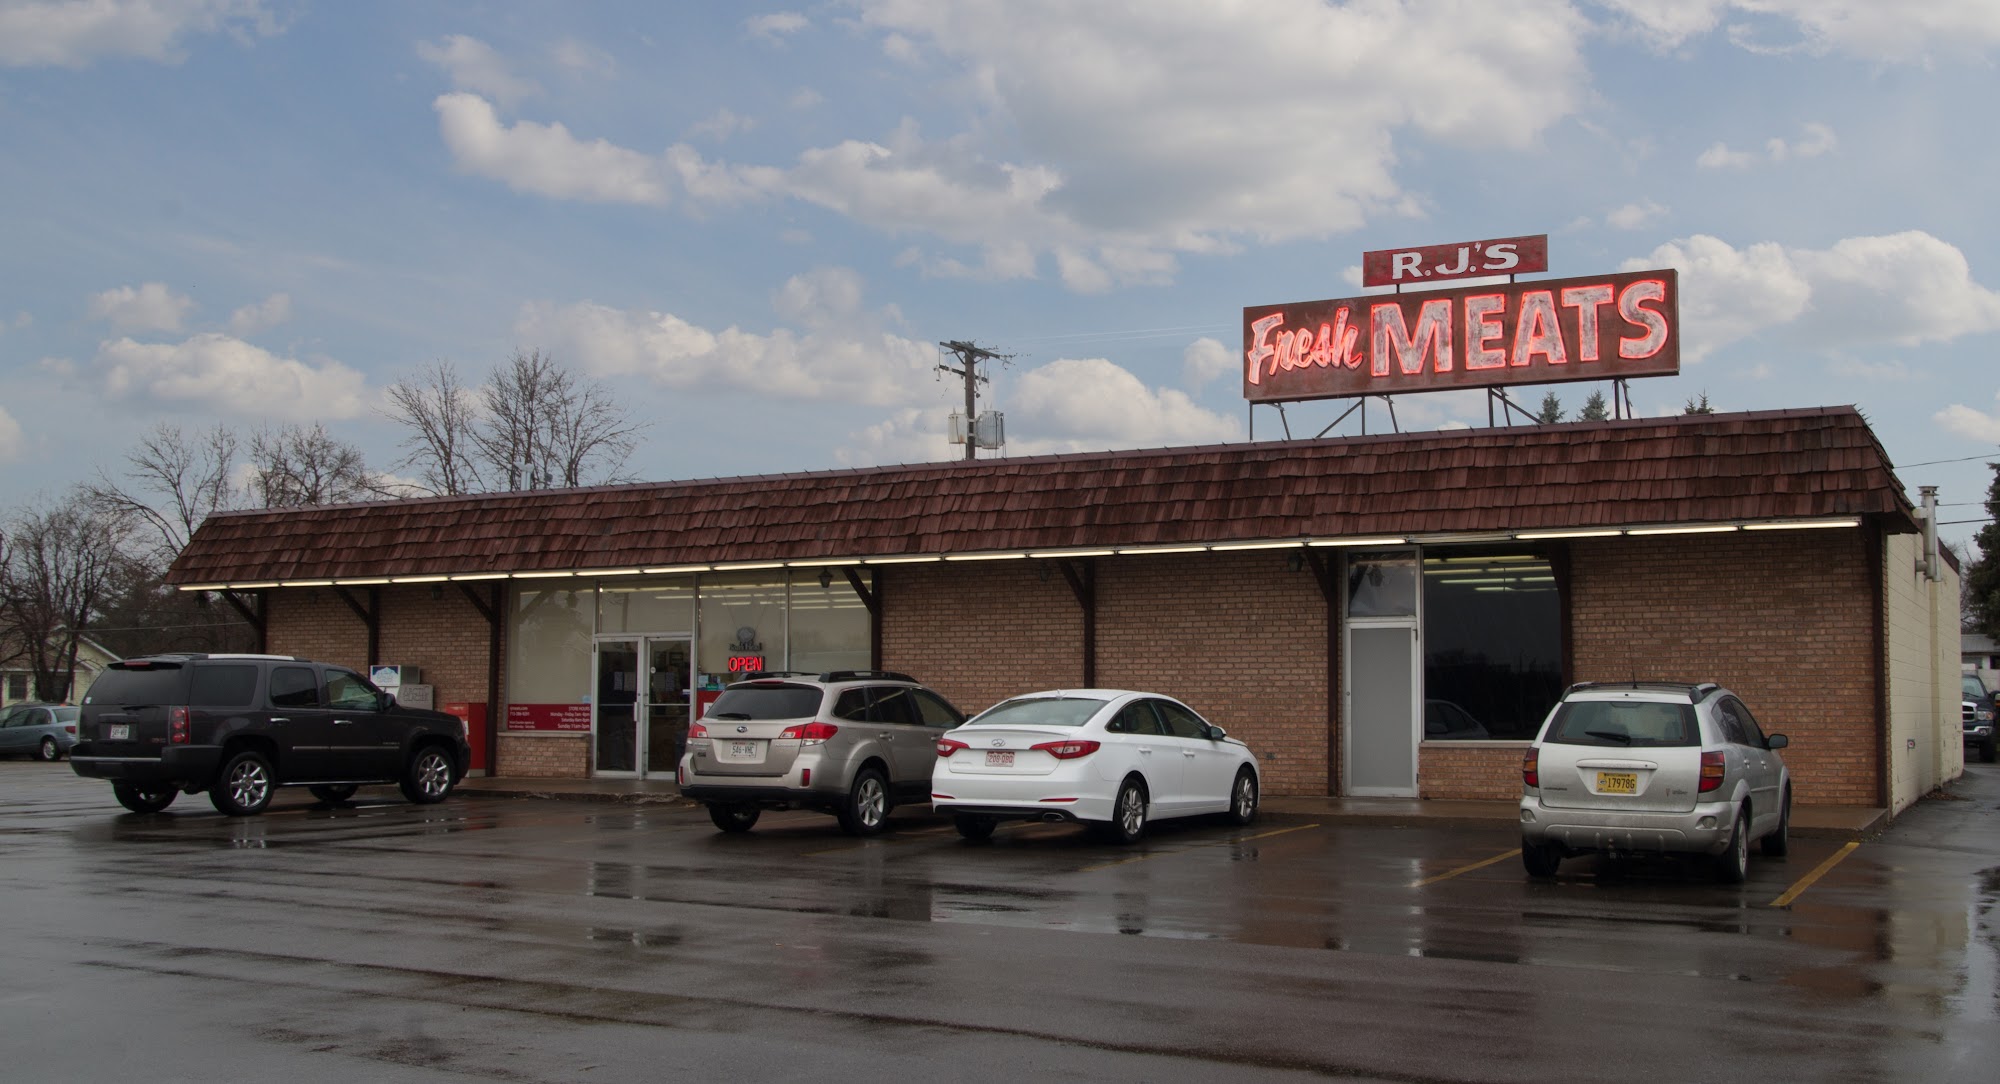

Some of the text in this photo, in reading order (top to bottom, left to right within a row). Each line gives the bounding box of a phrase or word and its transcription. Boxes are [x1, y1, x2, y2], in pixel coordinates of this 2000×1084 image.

[1391, 242, 1519, 280] R.J.'S
[1248, 279, 1669, 386] Fresh MEATS
[728, 656, 763, 672] OPEN
[1607, 777, 1635, 789] 17978G
